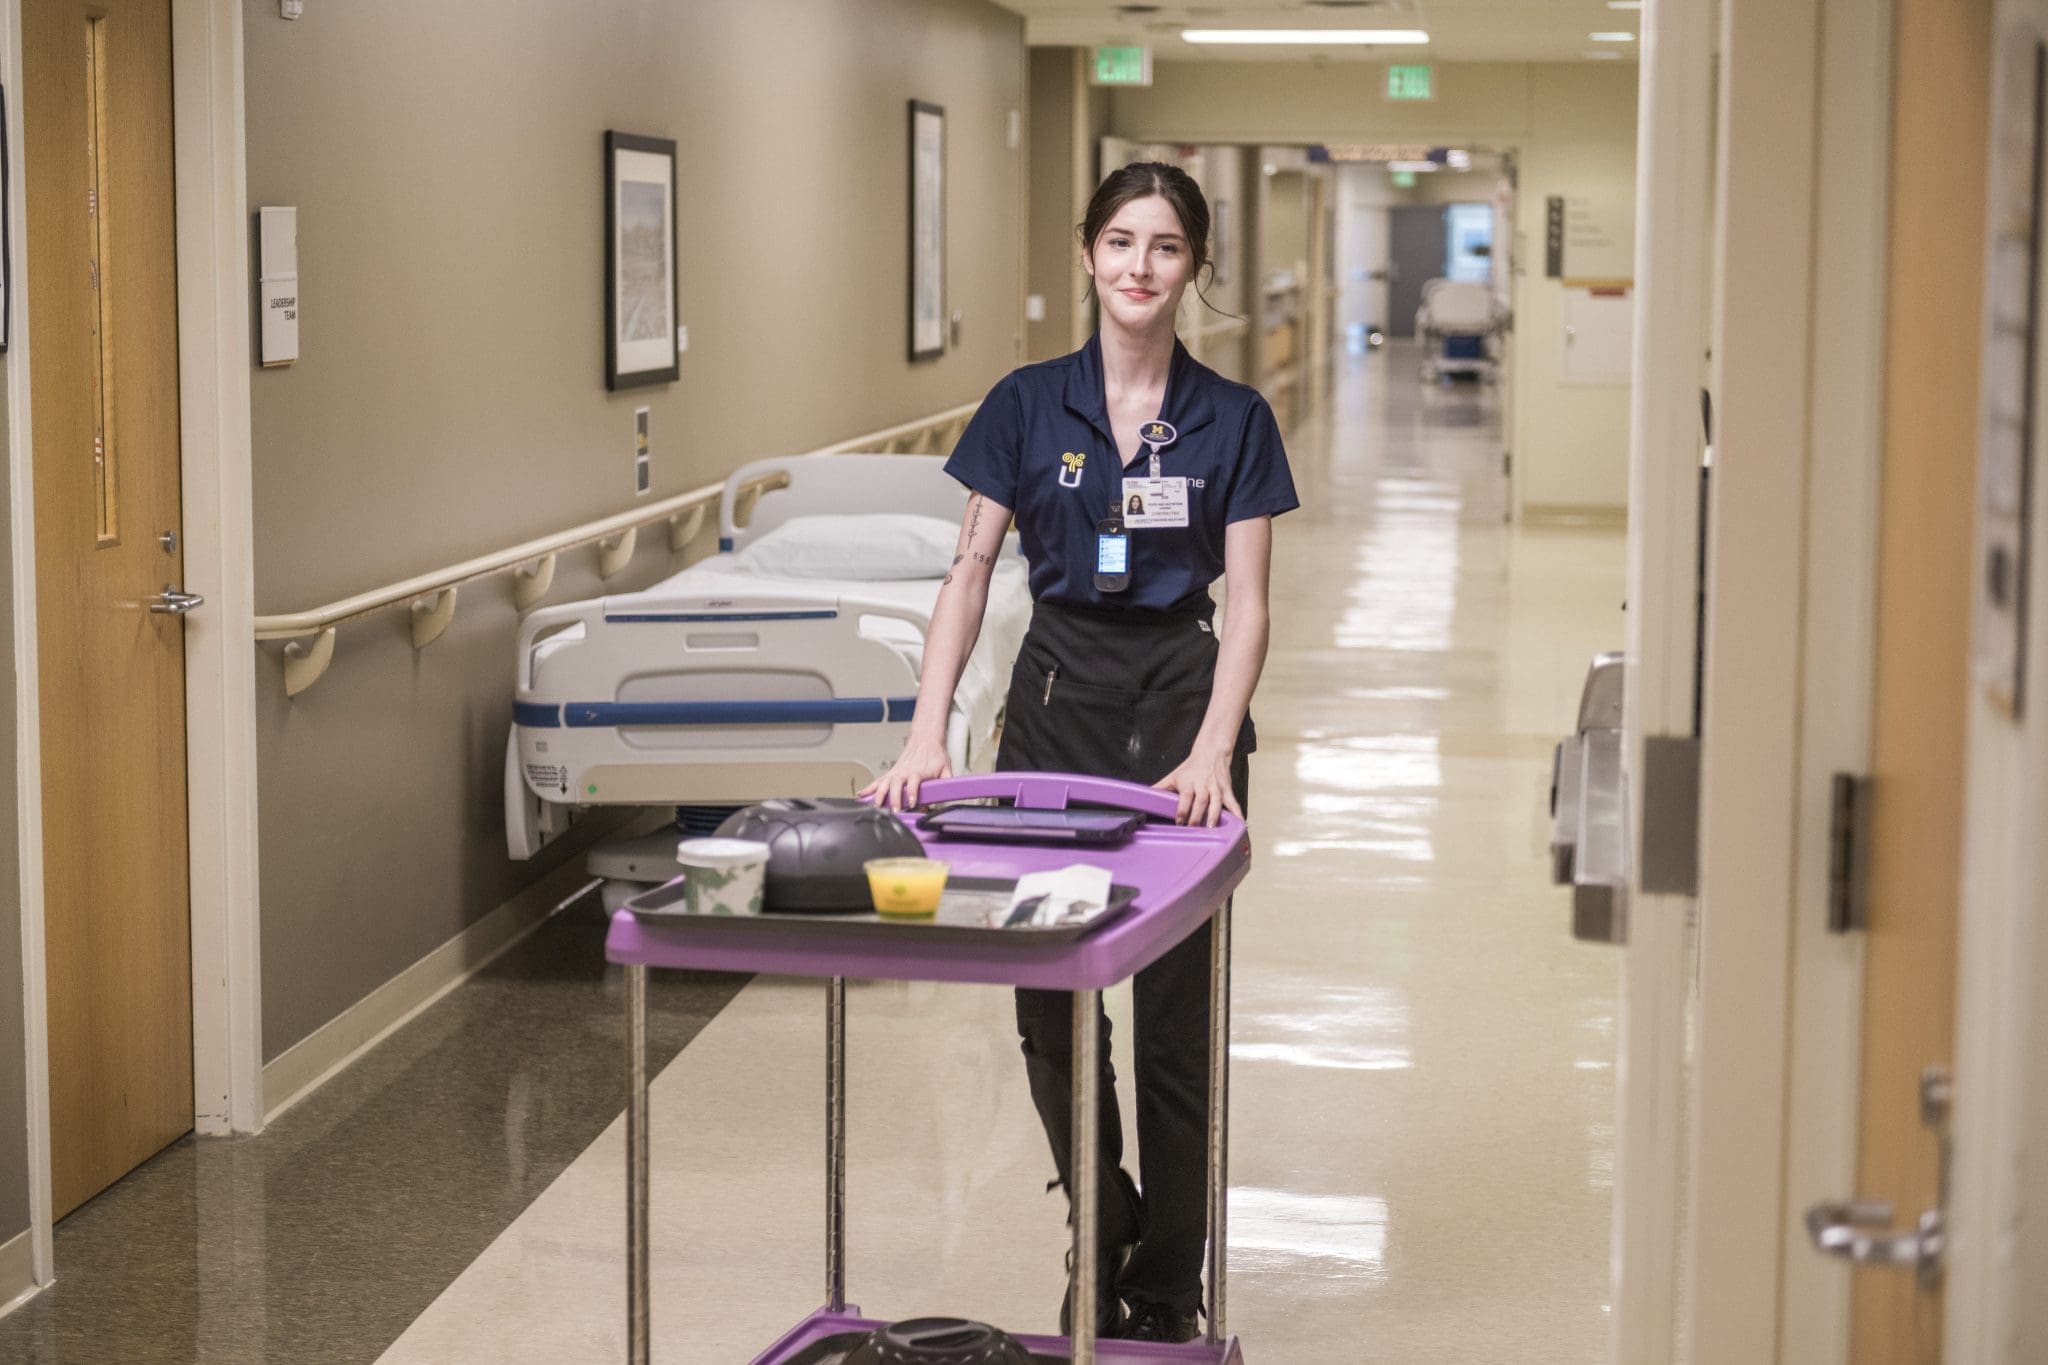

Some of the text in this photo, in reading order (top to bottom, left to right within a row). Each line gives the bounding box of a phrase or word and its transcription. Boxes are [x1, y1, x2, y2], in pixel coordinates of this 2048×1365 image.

[270, 297, 296, 308] LEADERSHIP
[284, 310, 296, 320] TEAM
[1152, 424, 1164, 434] M
[1186, 477, 1205, 488] ne
